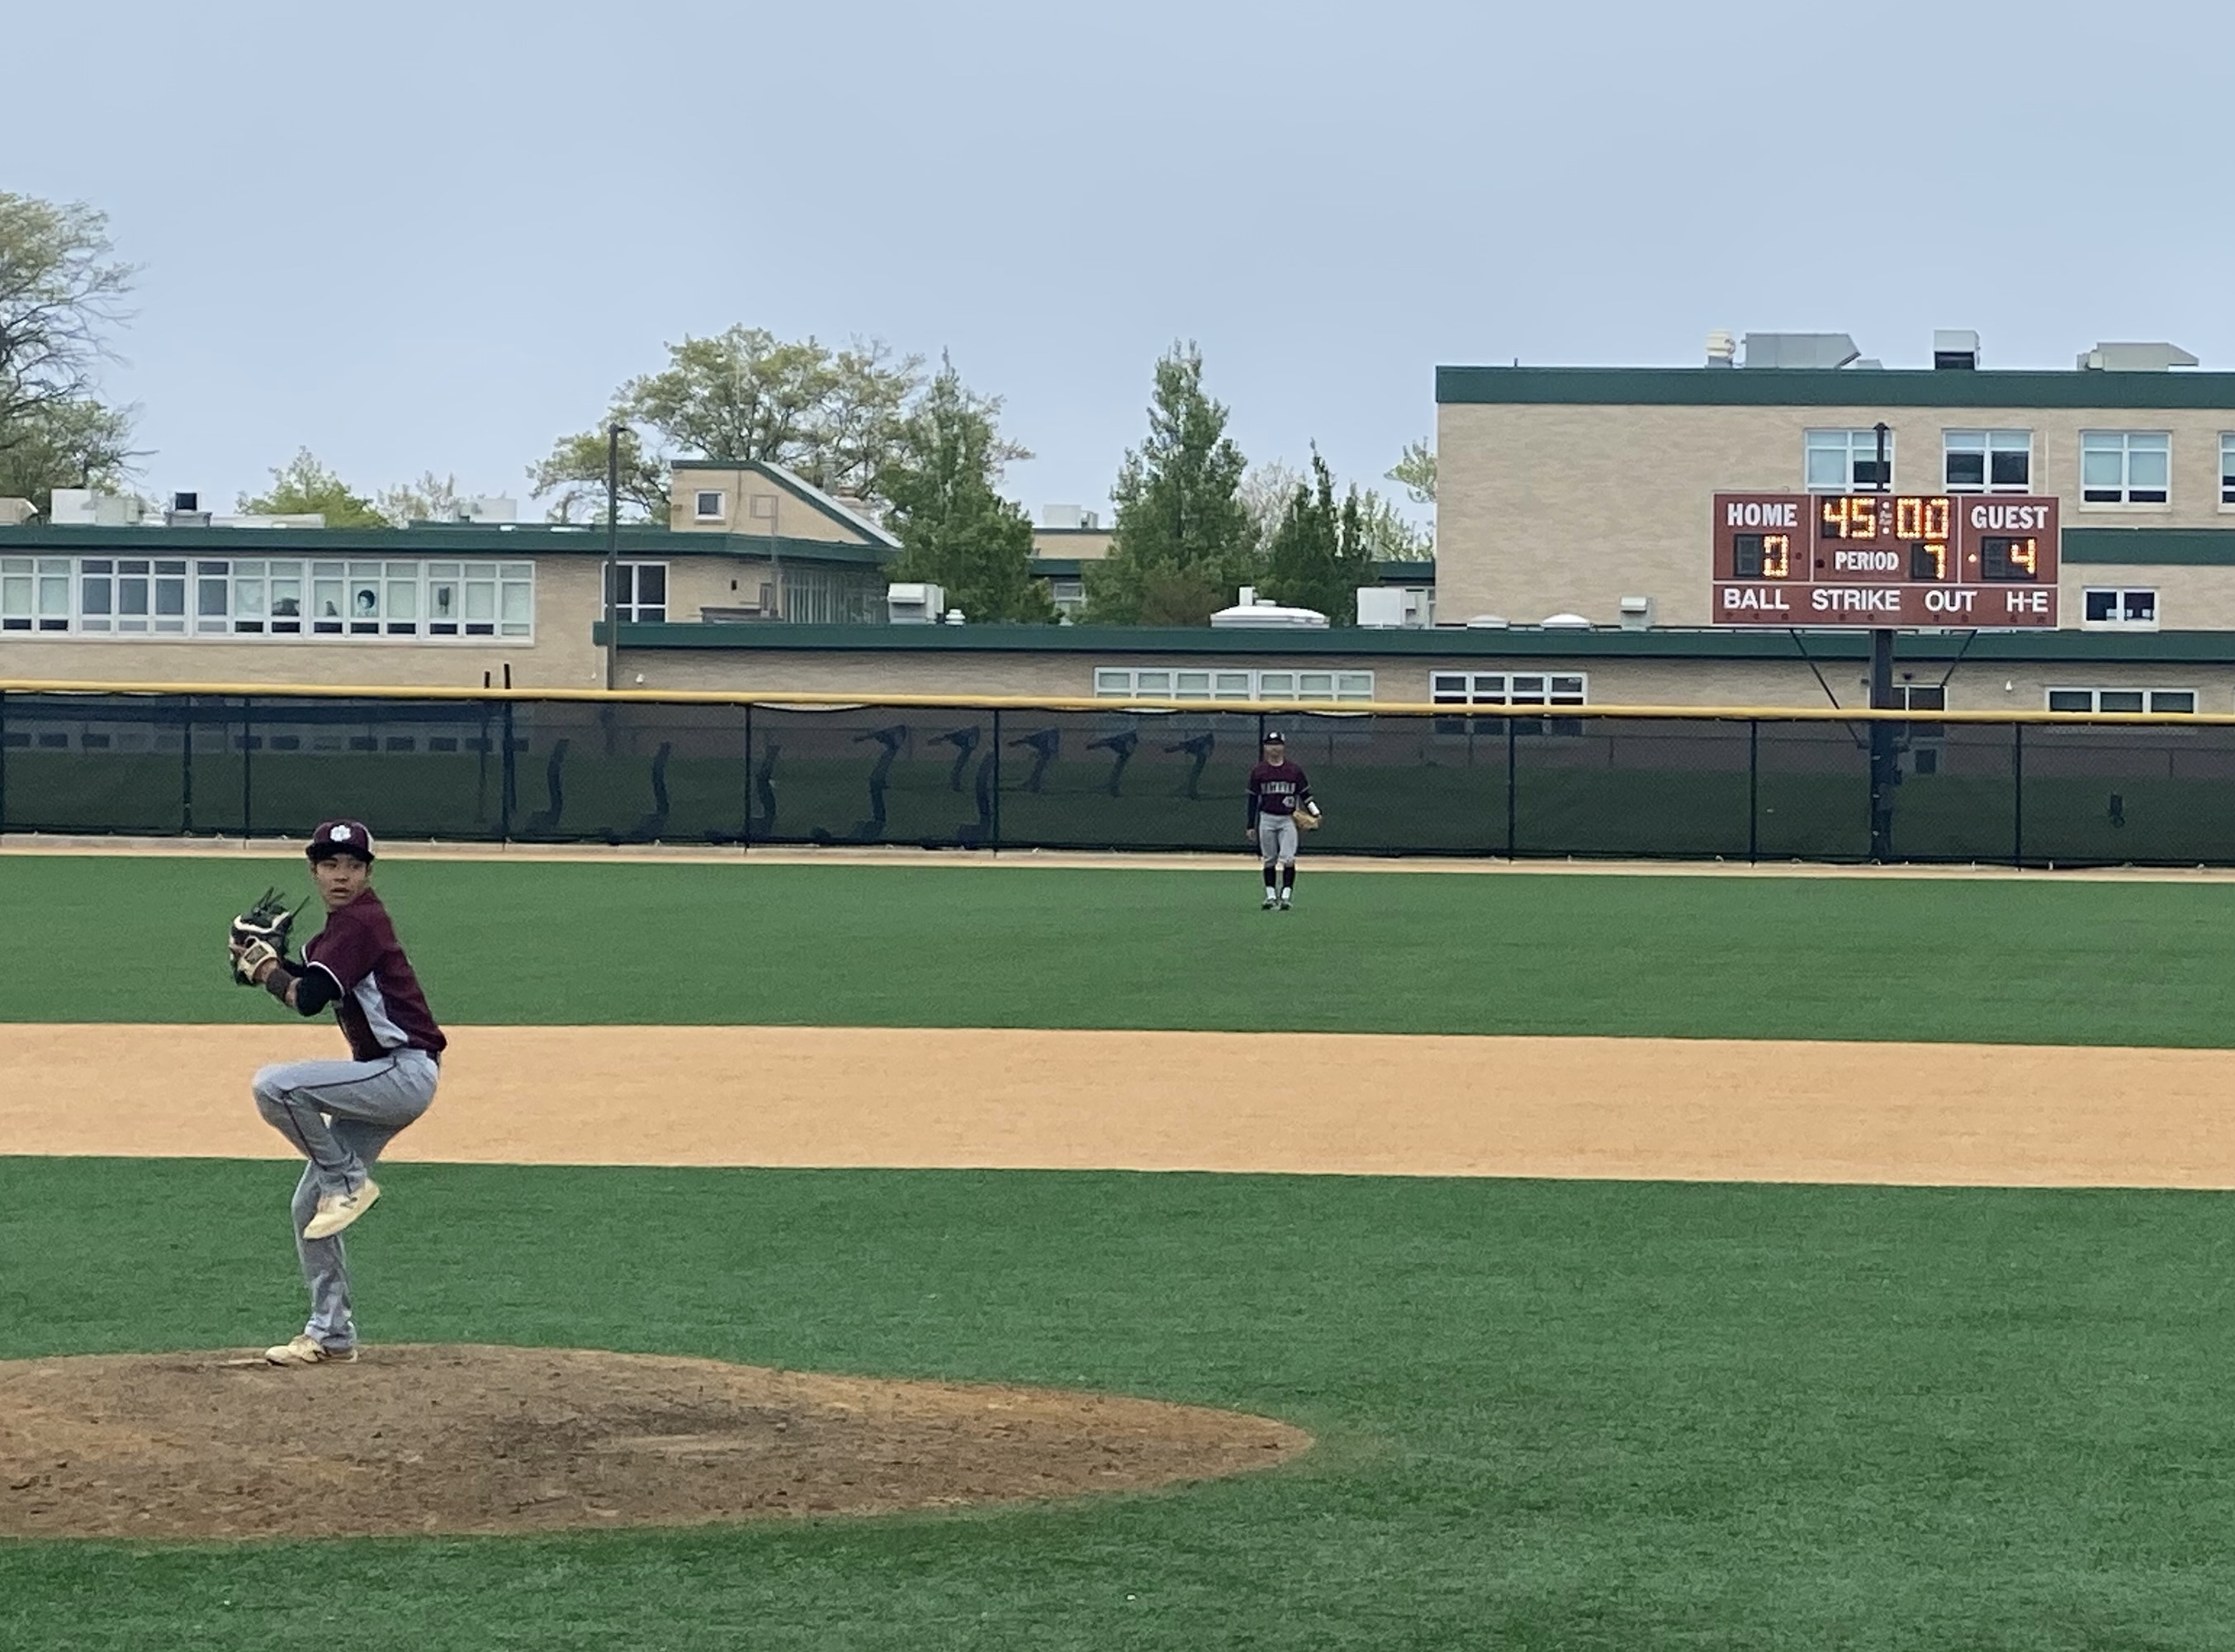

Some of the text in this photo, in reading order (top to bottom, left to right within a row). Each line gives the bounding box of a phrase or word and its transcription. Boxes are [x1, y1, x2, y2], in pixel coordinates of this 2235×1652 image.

[1726, 503, 1798, 527] HOME
[1823, 497, 1949, 538] 45:00
[1971, 505, 2048, 529] GUEST
[1763, 534, 1789, 576] 0
[1835, 551, 1900, 570] PERIOD
[1923, 544, 1946, 579] 7
[2010, 538, 2035, 574] 4
[1723, 589, 2049, 613] BALL STRIKE OUT H-E
